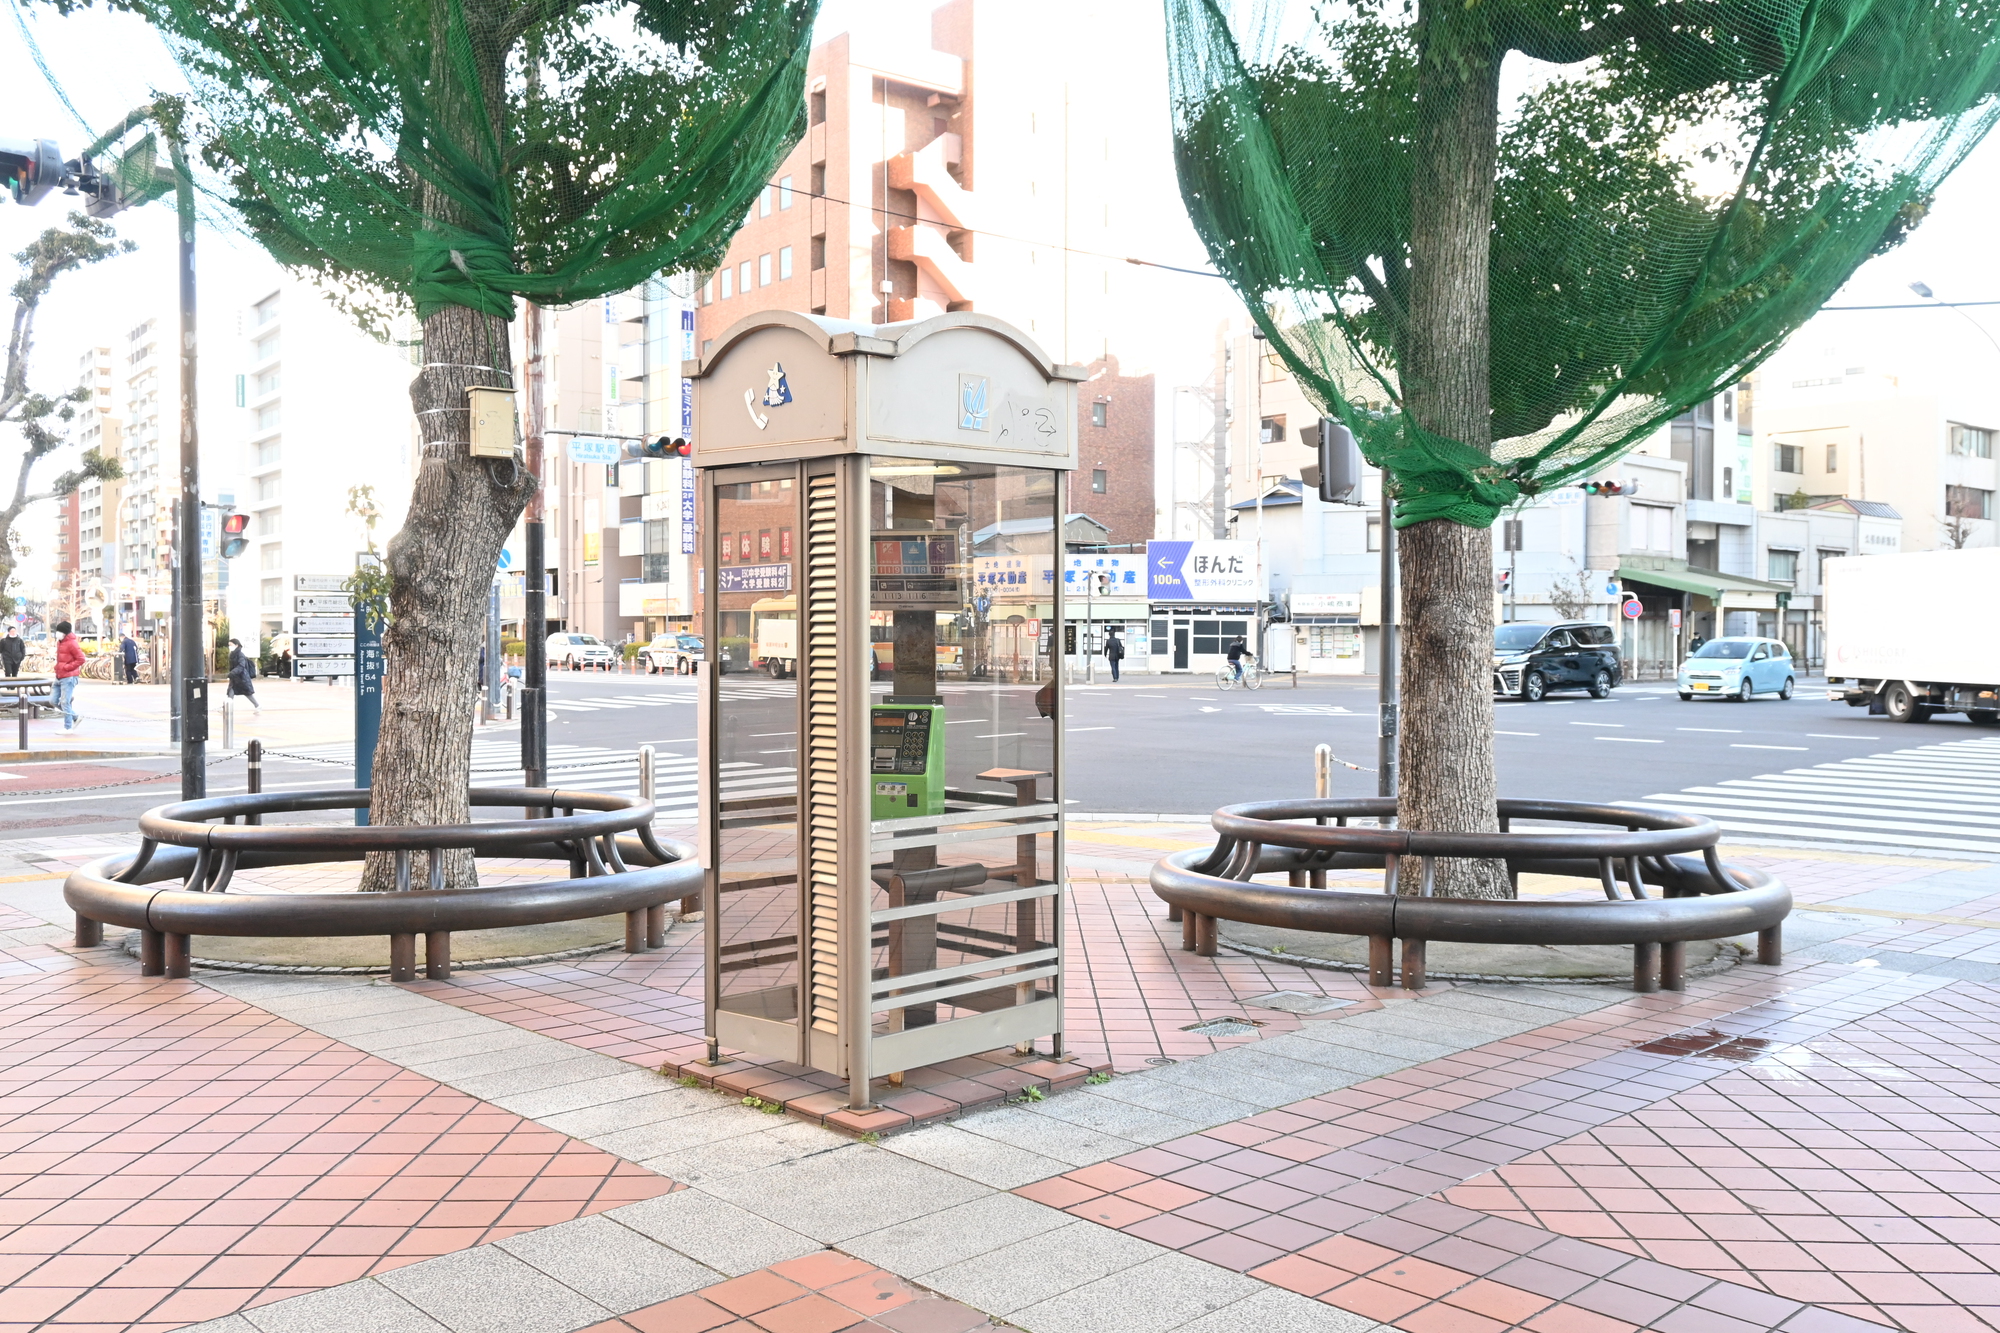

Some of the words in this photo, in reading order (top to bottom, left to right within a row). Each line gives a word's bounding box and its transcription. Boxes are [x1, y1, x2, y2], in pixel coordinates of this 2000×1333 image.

[572, 442, 617, 454] 平塚駅前
[1193, 555, 1243, 573] ほんだ
[719, 571, 742, 588] ミナー
[1153, 575, 1181, 584] 100m
